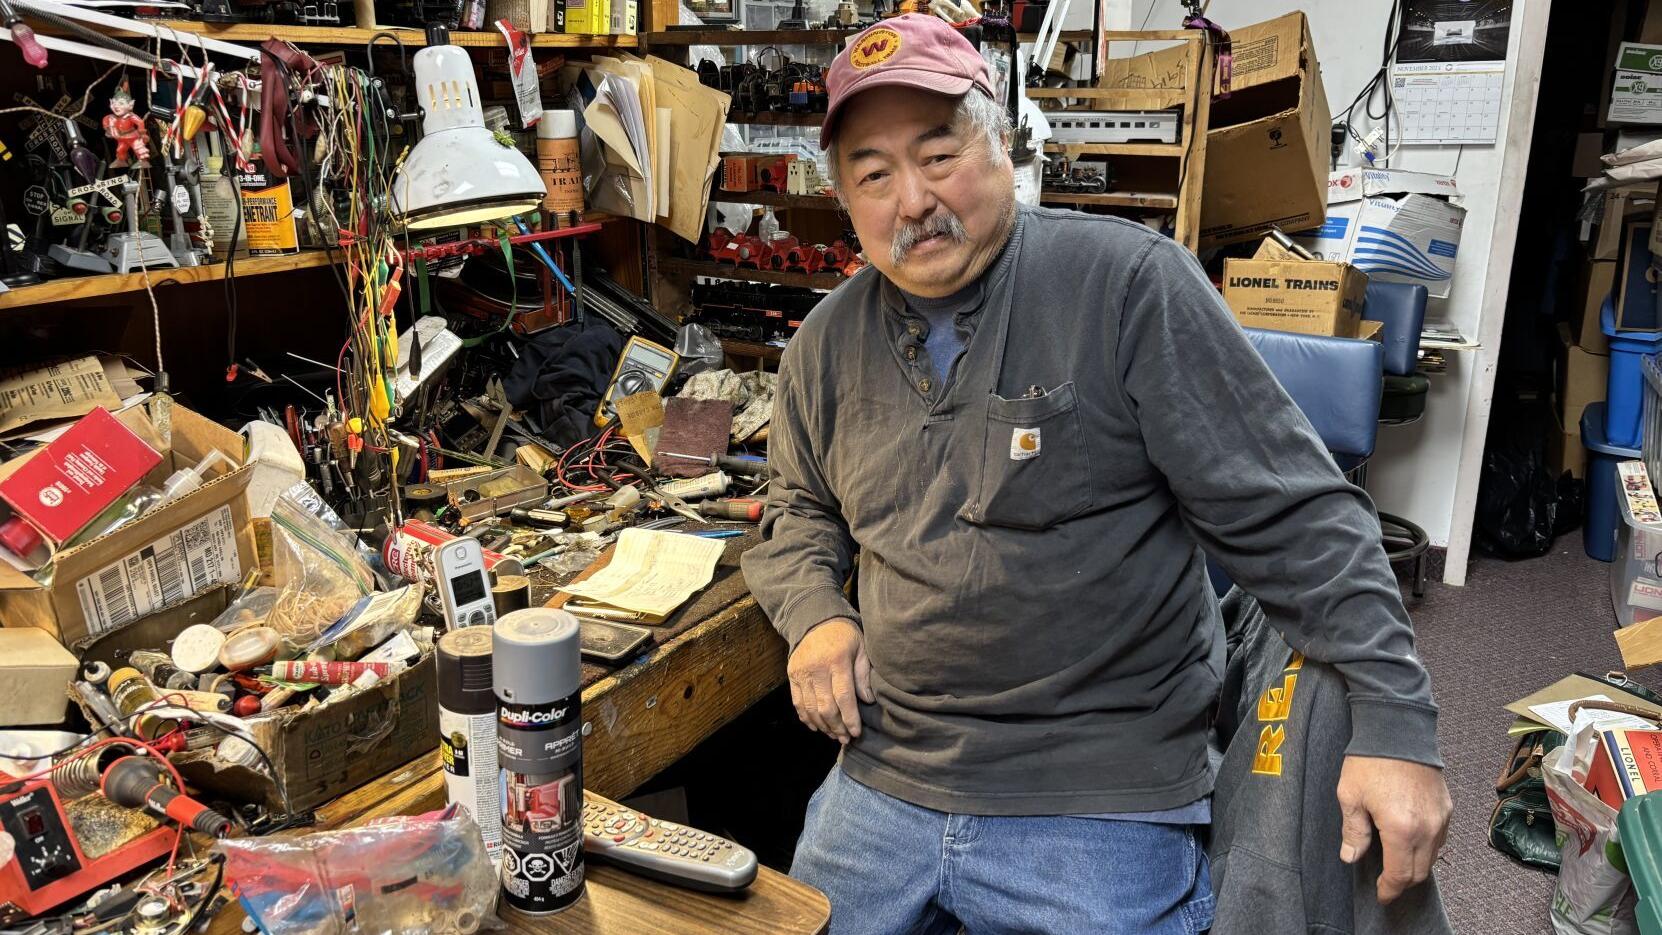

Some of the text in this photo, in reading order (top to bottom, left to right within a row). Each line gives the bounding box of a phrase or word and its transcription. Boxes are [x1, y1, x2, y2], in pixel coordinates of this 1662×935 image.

[861, 38, 889, 57] W
[243, 205, 278, 222] ENETRANT
[1229, 277, 1338, 291] LIONEL TRAINS
[501, 706, 567, 723] Dupli-Color
[1620, 747, 1641, 782] LIONEL
